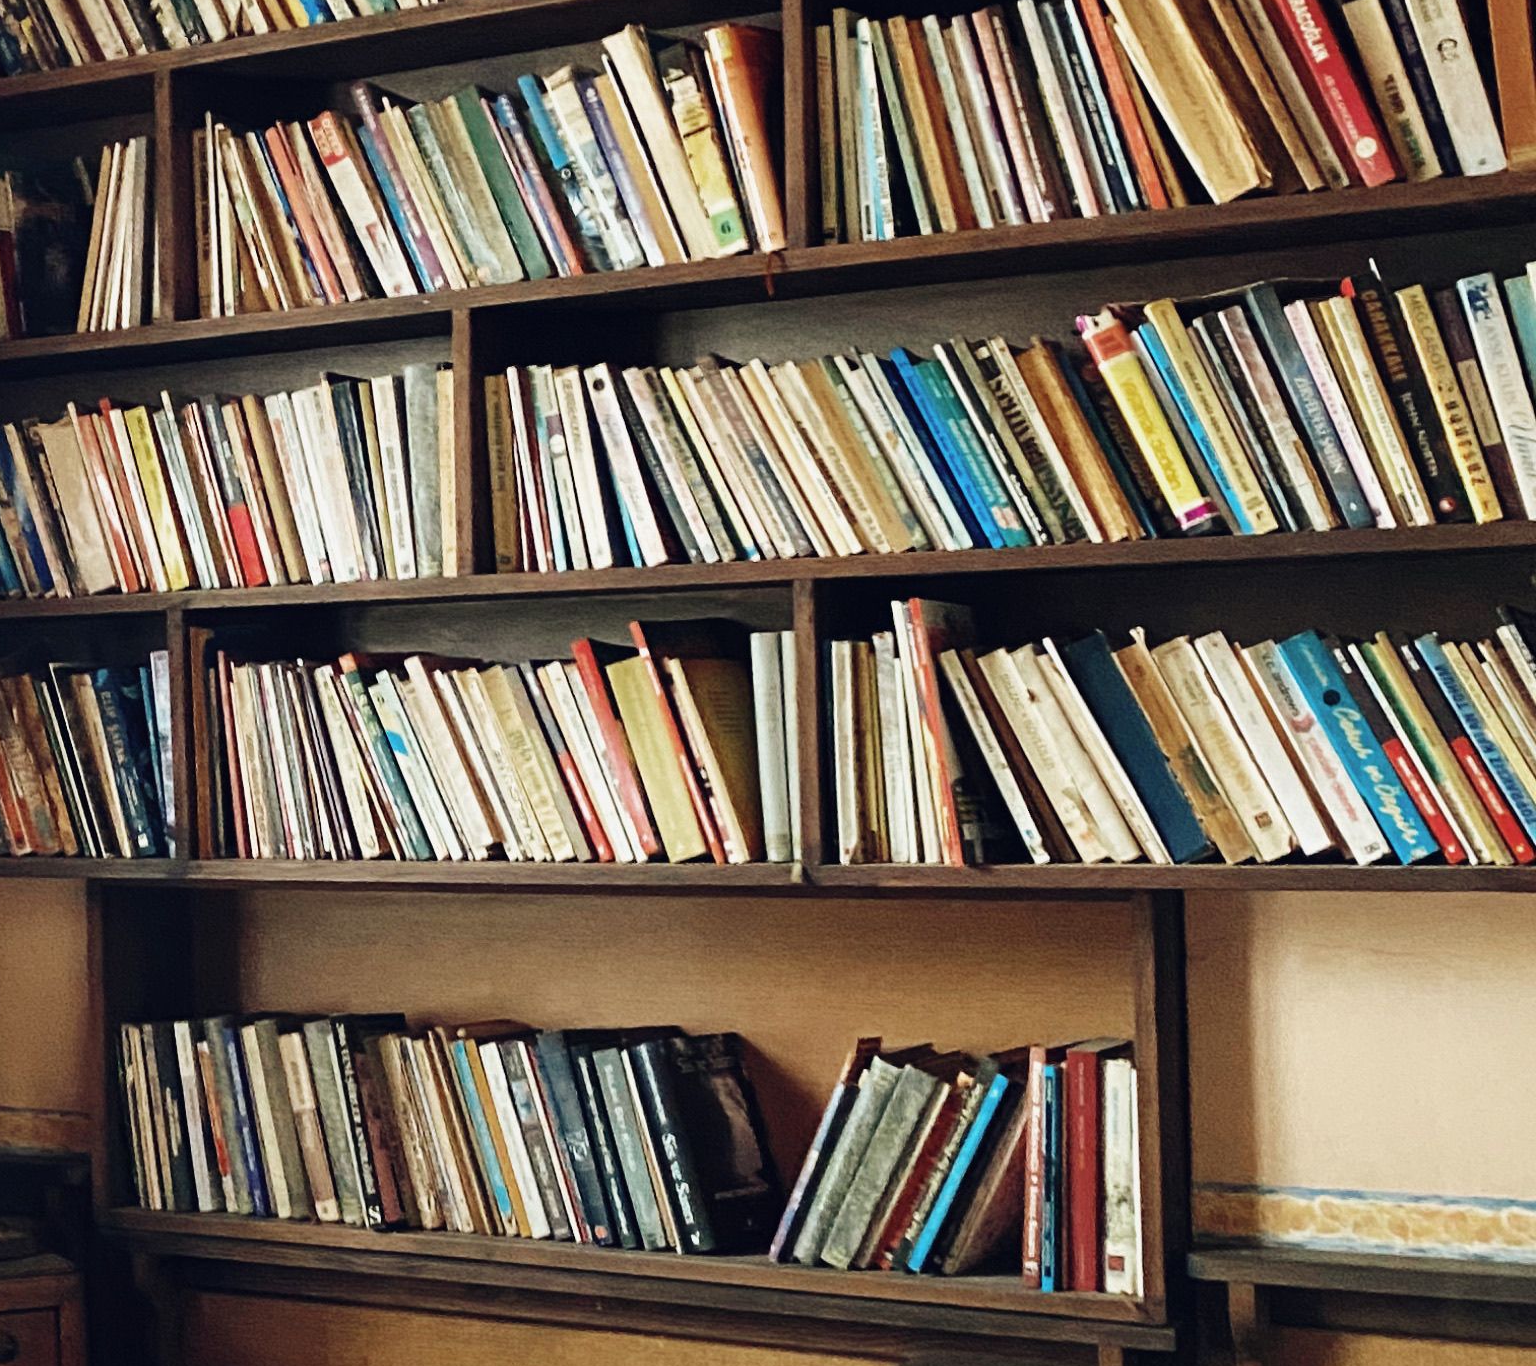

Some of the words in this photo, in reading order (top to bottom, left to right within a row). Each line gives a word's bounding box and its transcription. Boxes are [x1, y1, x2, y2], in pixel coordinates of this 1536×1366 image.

[1409, 293, 1427, 323] MEG
[1420, 324, 1447, 373] CABOT
[1400, 391, 1422, 428] JOHN
[1417, 429, 1441, 477] NORTH
